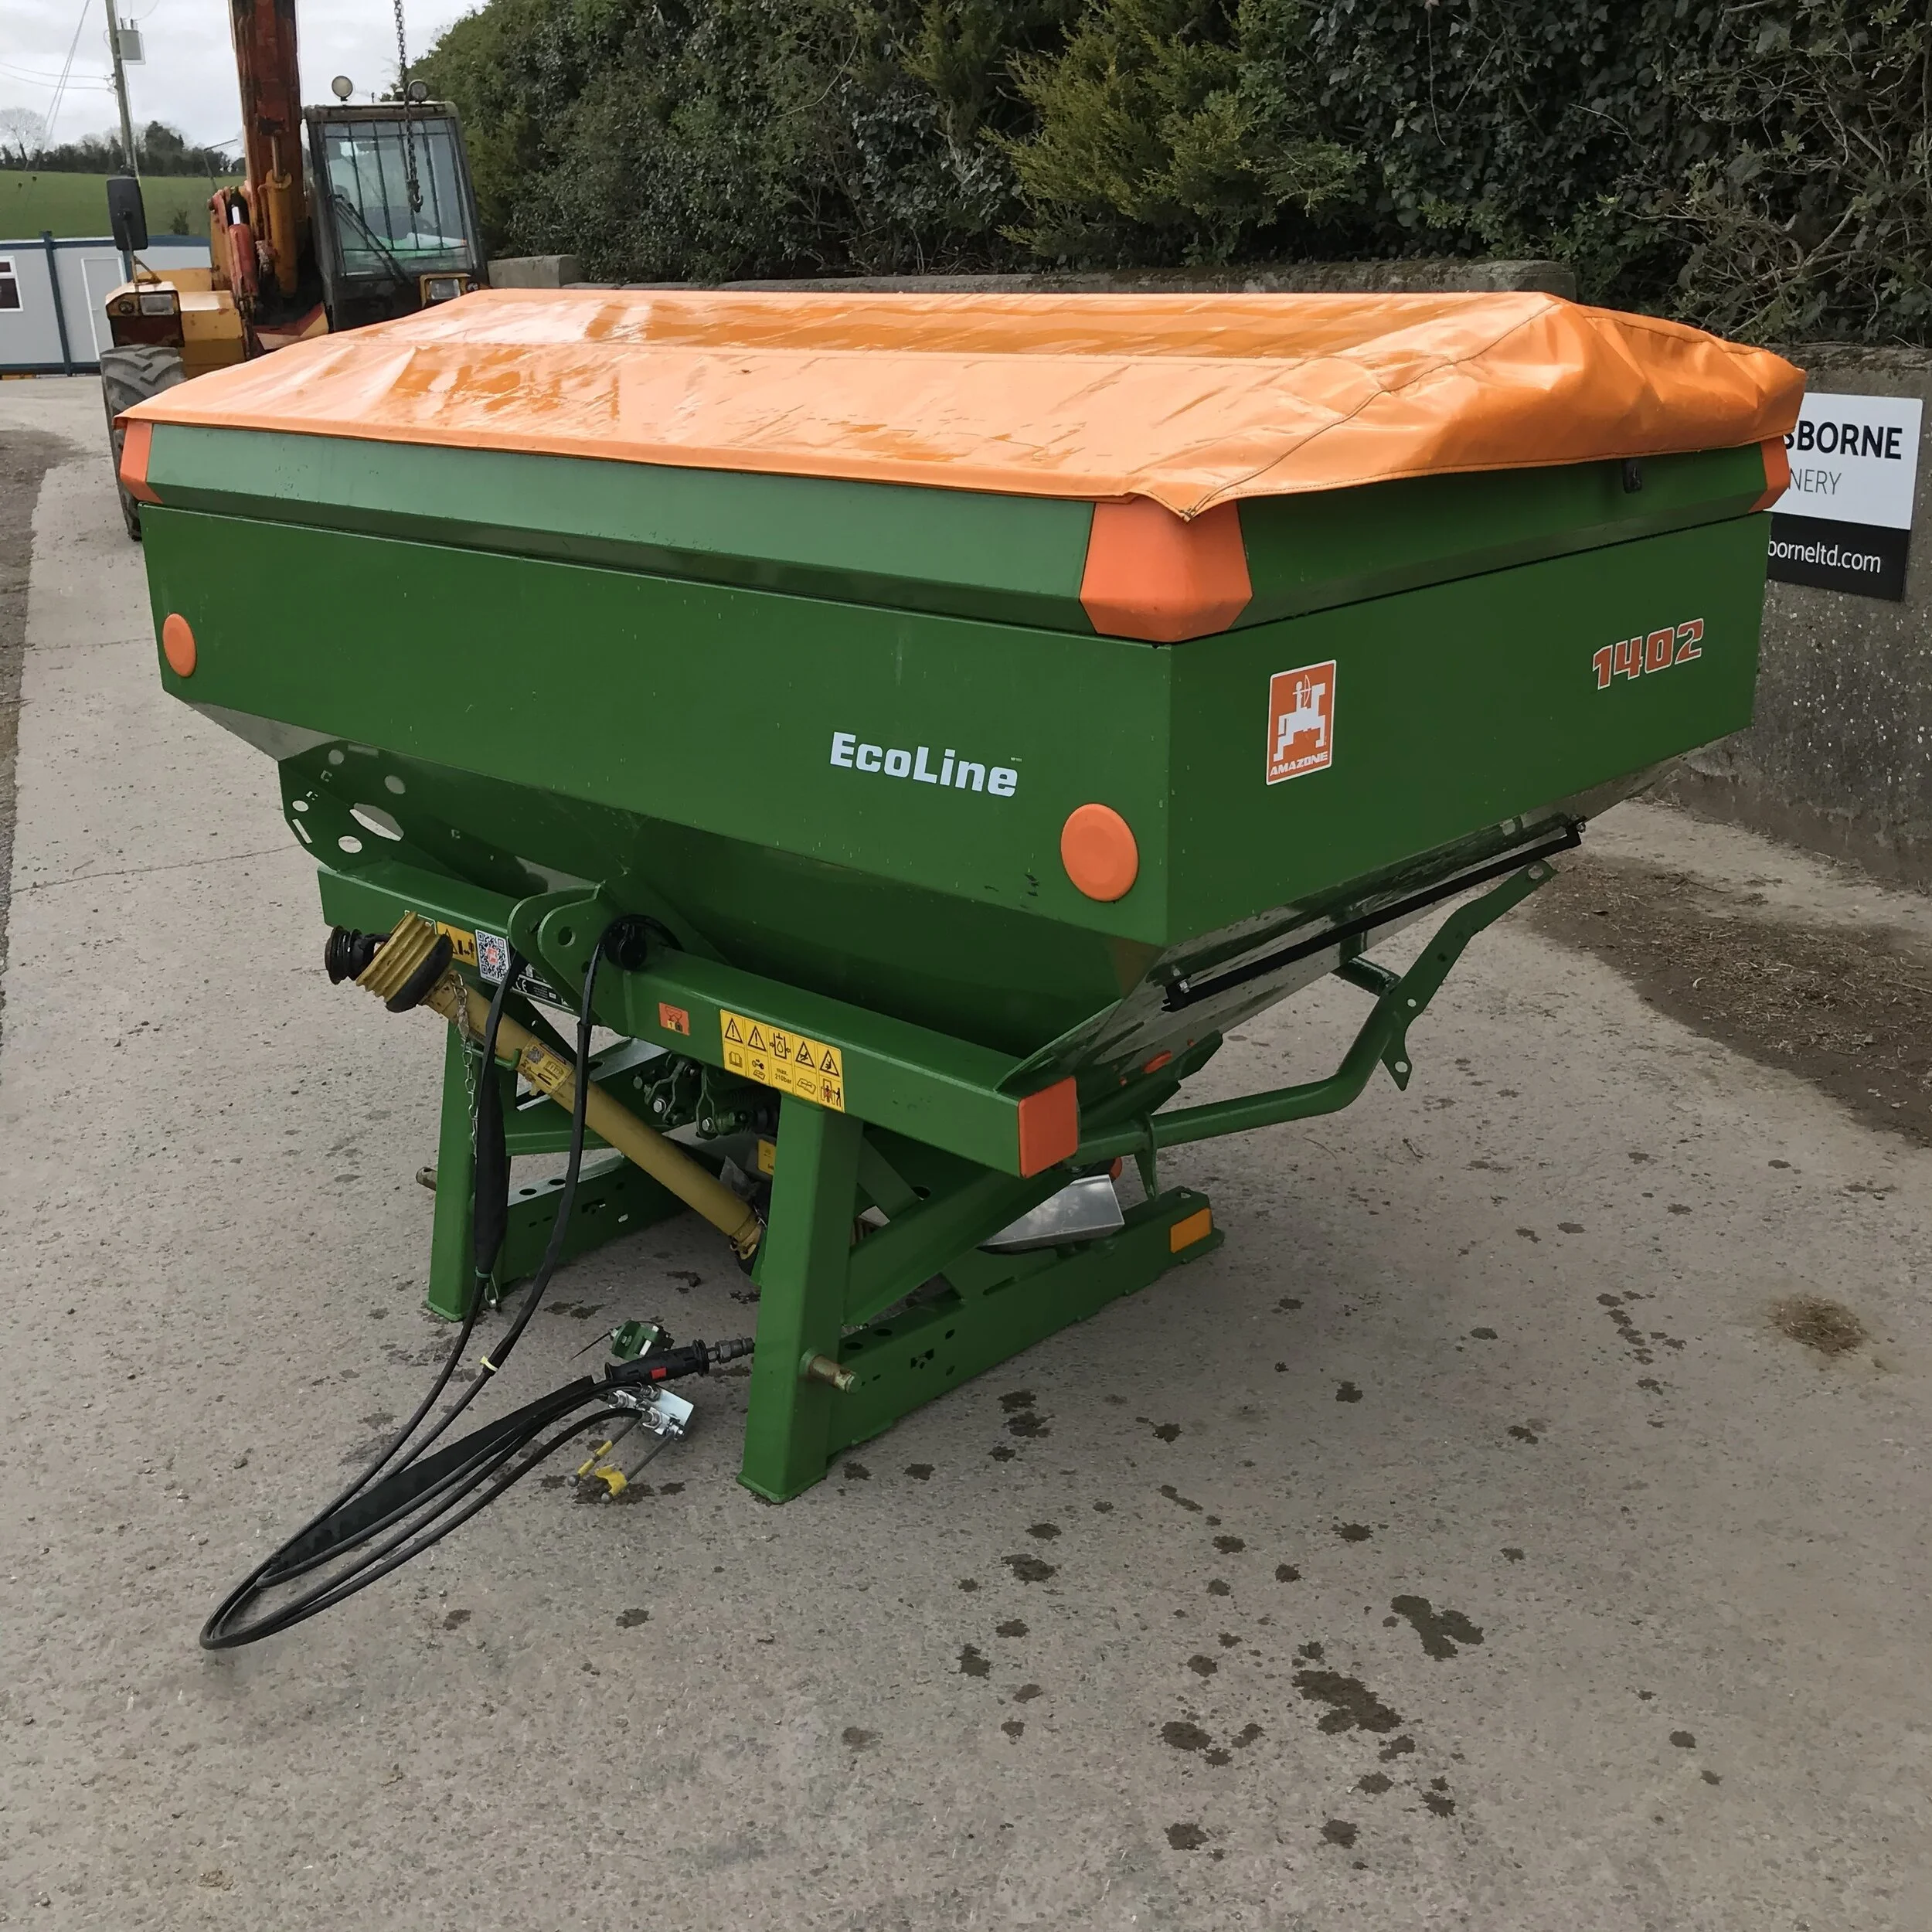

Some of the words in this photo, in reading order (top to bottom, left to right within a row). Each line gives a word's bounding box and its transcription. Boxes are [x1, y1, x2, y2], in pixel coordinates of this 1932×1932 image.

[1768, 536, 1881, 573] borneltd.com
[1593, 618, 1704, 690] 1402
[830, 731, 1019, 798] EcoLine
[1270, 751, 1328, 777] AMAZONE
